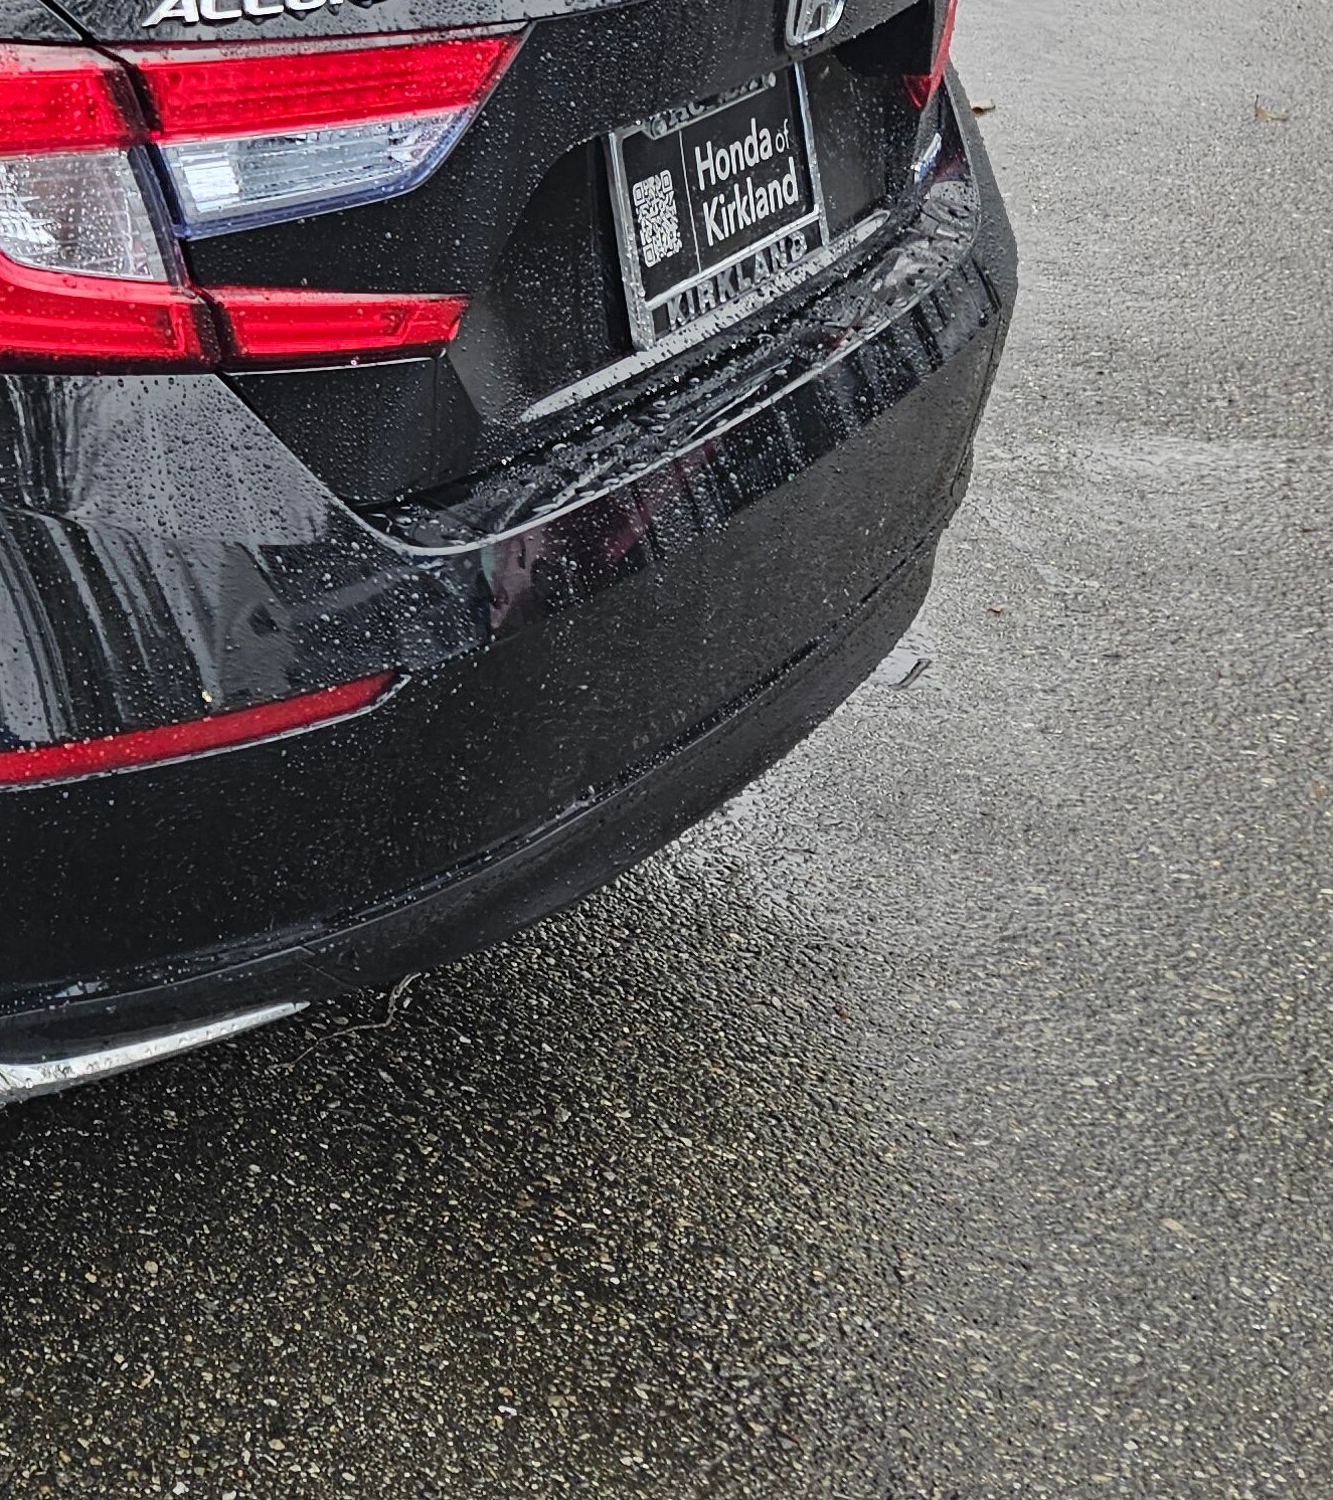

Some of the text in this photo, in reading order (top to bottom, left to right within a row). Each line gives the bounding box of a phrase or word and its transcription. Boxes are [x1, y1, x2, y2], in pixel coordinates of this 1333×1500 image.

[694, 117, 773, 191] Honda
[775, 118, 789, 153] of
[702, 156, 799, 247] Kirkland
[667, 231, 808, 331] KIRKLAND
